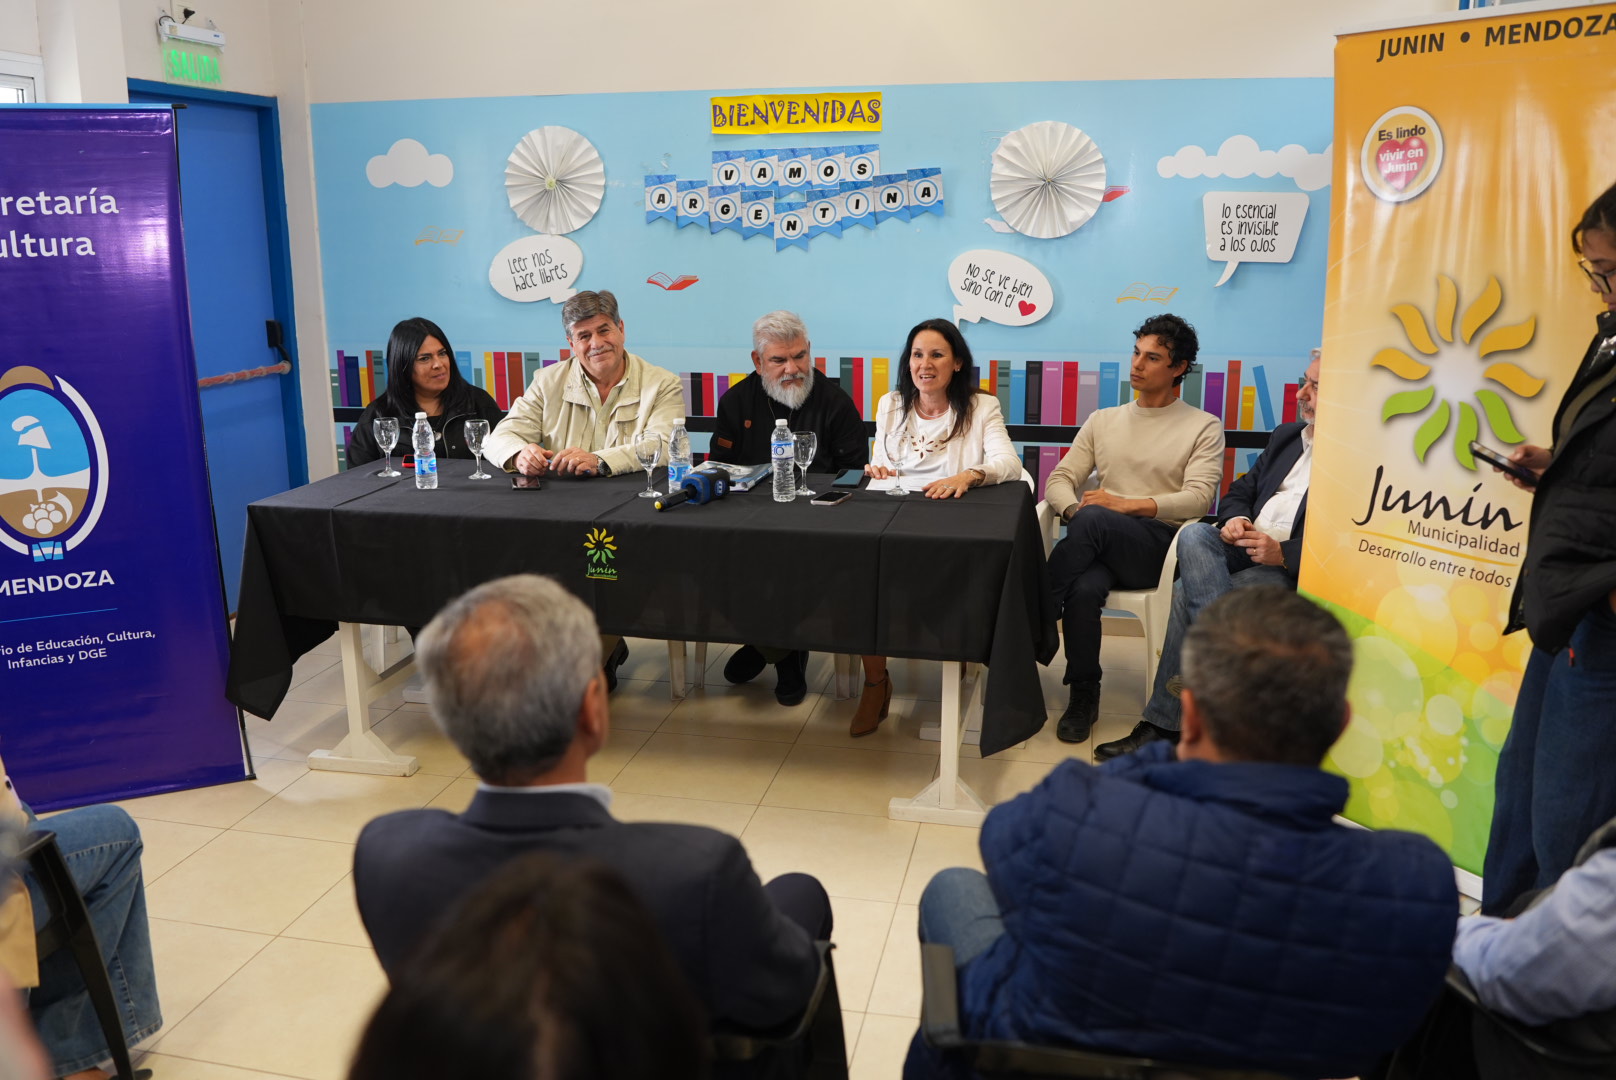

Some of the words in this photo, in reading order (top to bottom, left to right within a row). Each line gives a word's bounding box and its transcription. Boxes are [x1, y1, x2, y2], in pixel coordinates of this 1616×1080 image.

[1376, 32, 1445, 63] JUNIN
[1484, 13, 1616, 47] MENDOZA
[170, 49, 223, 85] SALIDA
[712, 98, 882, 128] BIENVENIDAS
[1378, 129, 1394, 142] Es
[1396, 124, 1427, 139] lindo
[1379, 148, 1406, 163] vivir
[1407, 147, 1424, 159] en
[724, 163, 868, 182] VAMOS
[656, 186, 932, 232] ARGENTINA
[1222, 203, 1232, 219] lo
[1236, 203, 1277, 219] esencial
[1221, 220, 1233, 235] es
[1237, 220, 1279, 236] invisible
[1220, 237, 1226, 251] a
[1230, 236, 1246, 252] los
[507, 256, 528, 275] Leer
[531, 248, 553, 268] nos
[513, 271, 538, 292] hace
[539, 263, 568, 285] libres
[966, 262, 981, 279] No
[982, 268, 996, 284] se
[998, 274, 1011, 290] ve
[1011, 278, 1034, 299] bien
[960, 277, 982, 296] sino
[984, 286, 1004, 305] con
[1004, 294, 1016, 309] el
[1351, 464, 1523, 532] Junín
[1408, 519, 1521, 558] Municipalidad
[1358, 538, 1427, 567] Desarrollo
[1429, 558, 1467, 578] entre
[1470, 567, 1513, 589] todos
[17, 642, 33, 654] de
[36, 634, 104, 652] Educación,
[106, 630, 156, 643] Cultura,
[7, 655, 65, 670] Infancias
[67, 653, 75, 665] y
[78, 647, 108, 661] DGE
